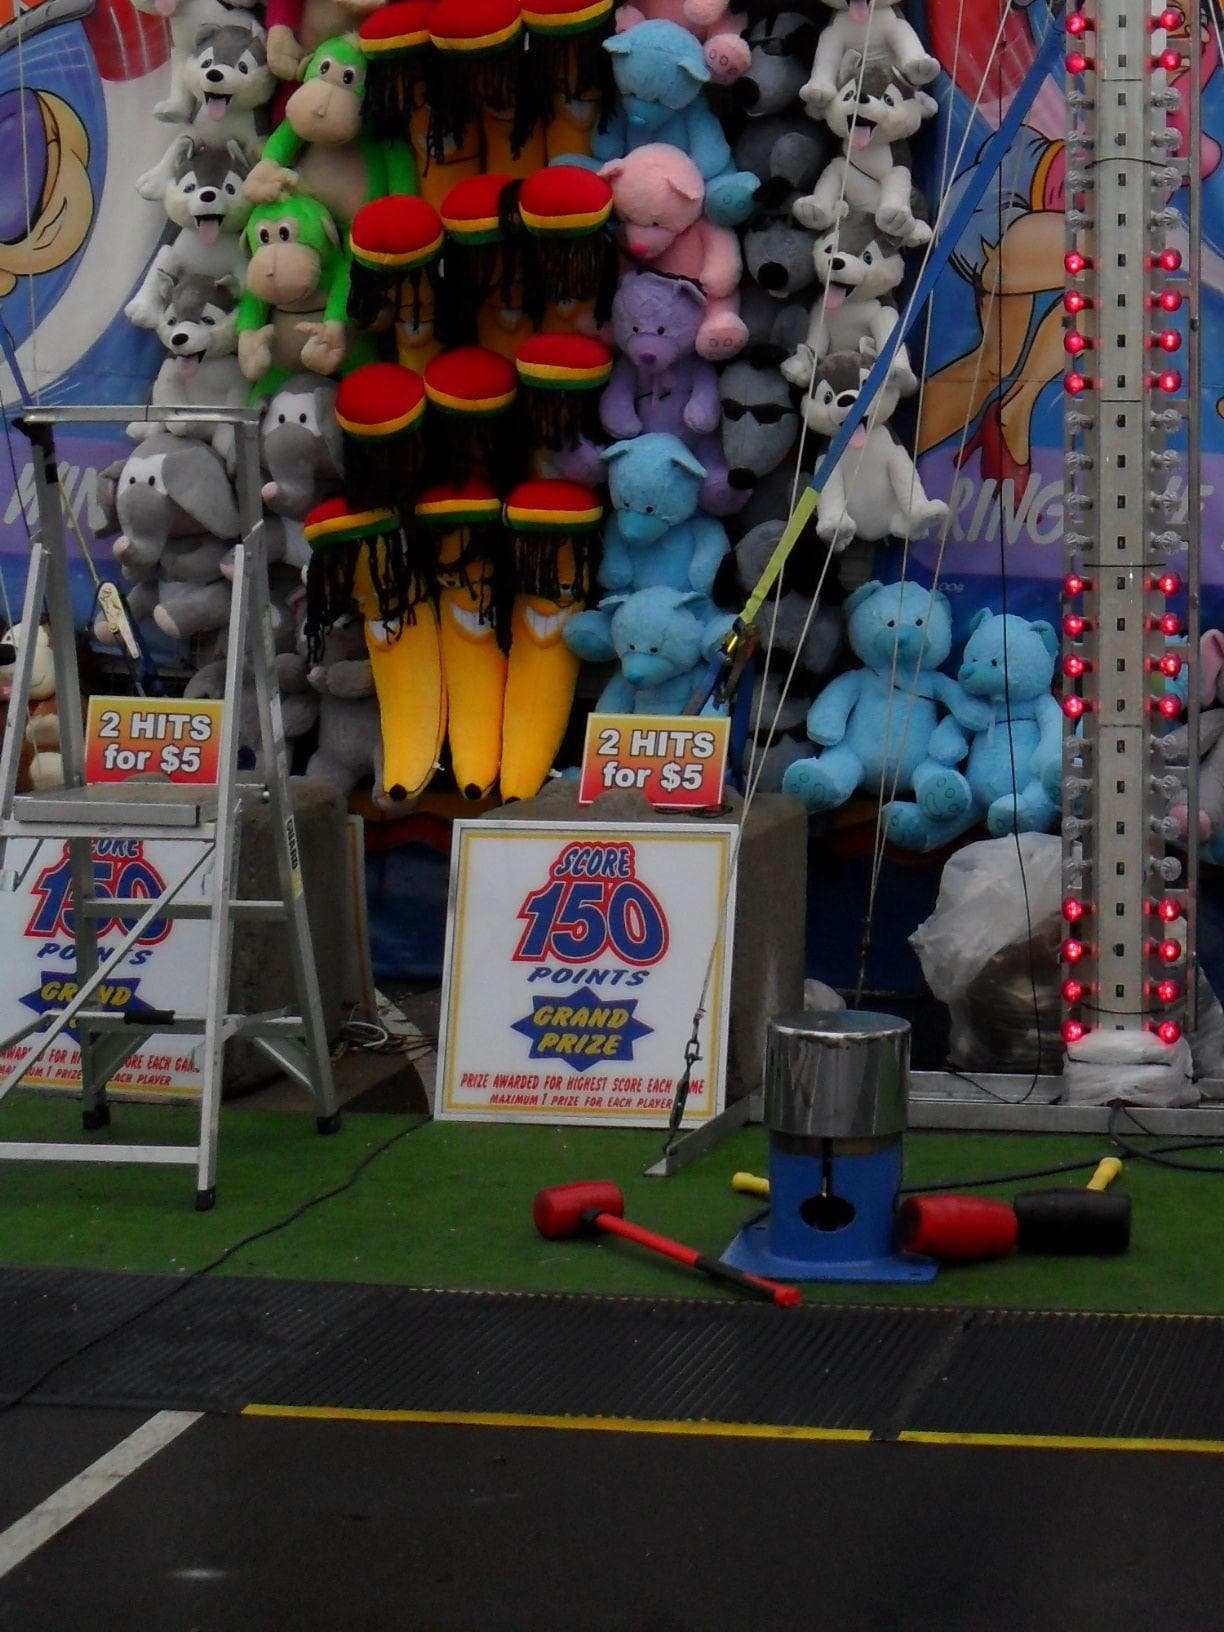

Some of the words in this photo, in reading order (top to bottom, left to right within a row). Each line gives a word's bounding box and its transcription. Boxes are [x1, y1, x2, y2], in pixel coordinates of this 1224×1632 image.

[98, 711, 121, 738] 2
[130, 712, 212, 741] HITS
[597, 728, 621, 756] 2
[630, 729, 715, 759] HITS
[104, 743, 151, 770] for
[160, 744, 201, 774] $5
[602, 760, 651, 788] for
[660, 761, 704, 792] $5
[555, 848, 630, 877] SCORE
[518, 882, 667, 961] 150
[527, 967, 650, 987] POINTS
[41, 981, 132, 1006] GRND
[533, 1006, 630, 1029] GRAND
[537, 1033, 622, 1056] PRIZE
[460, 1073, 488, 1088] PRIZE
[493, 1074, 540, 1090] AWARDED
[544, 1075, 562, 1090] FOR
[567, 1076, 608, 1093] HIGHEST
[612, 1077, 643, 1093] SCORE
[646, 1078, 672, 1094] EACH
[489, 1093, 538, 1105] MAXIMUM
[551, 1095, 579, 1107] PRIZE
[584, 1095, 603, 1107] FOR
[607, 1096, 632, 1108] EACH
[636, 1097, 673, 1109] PLAYER
